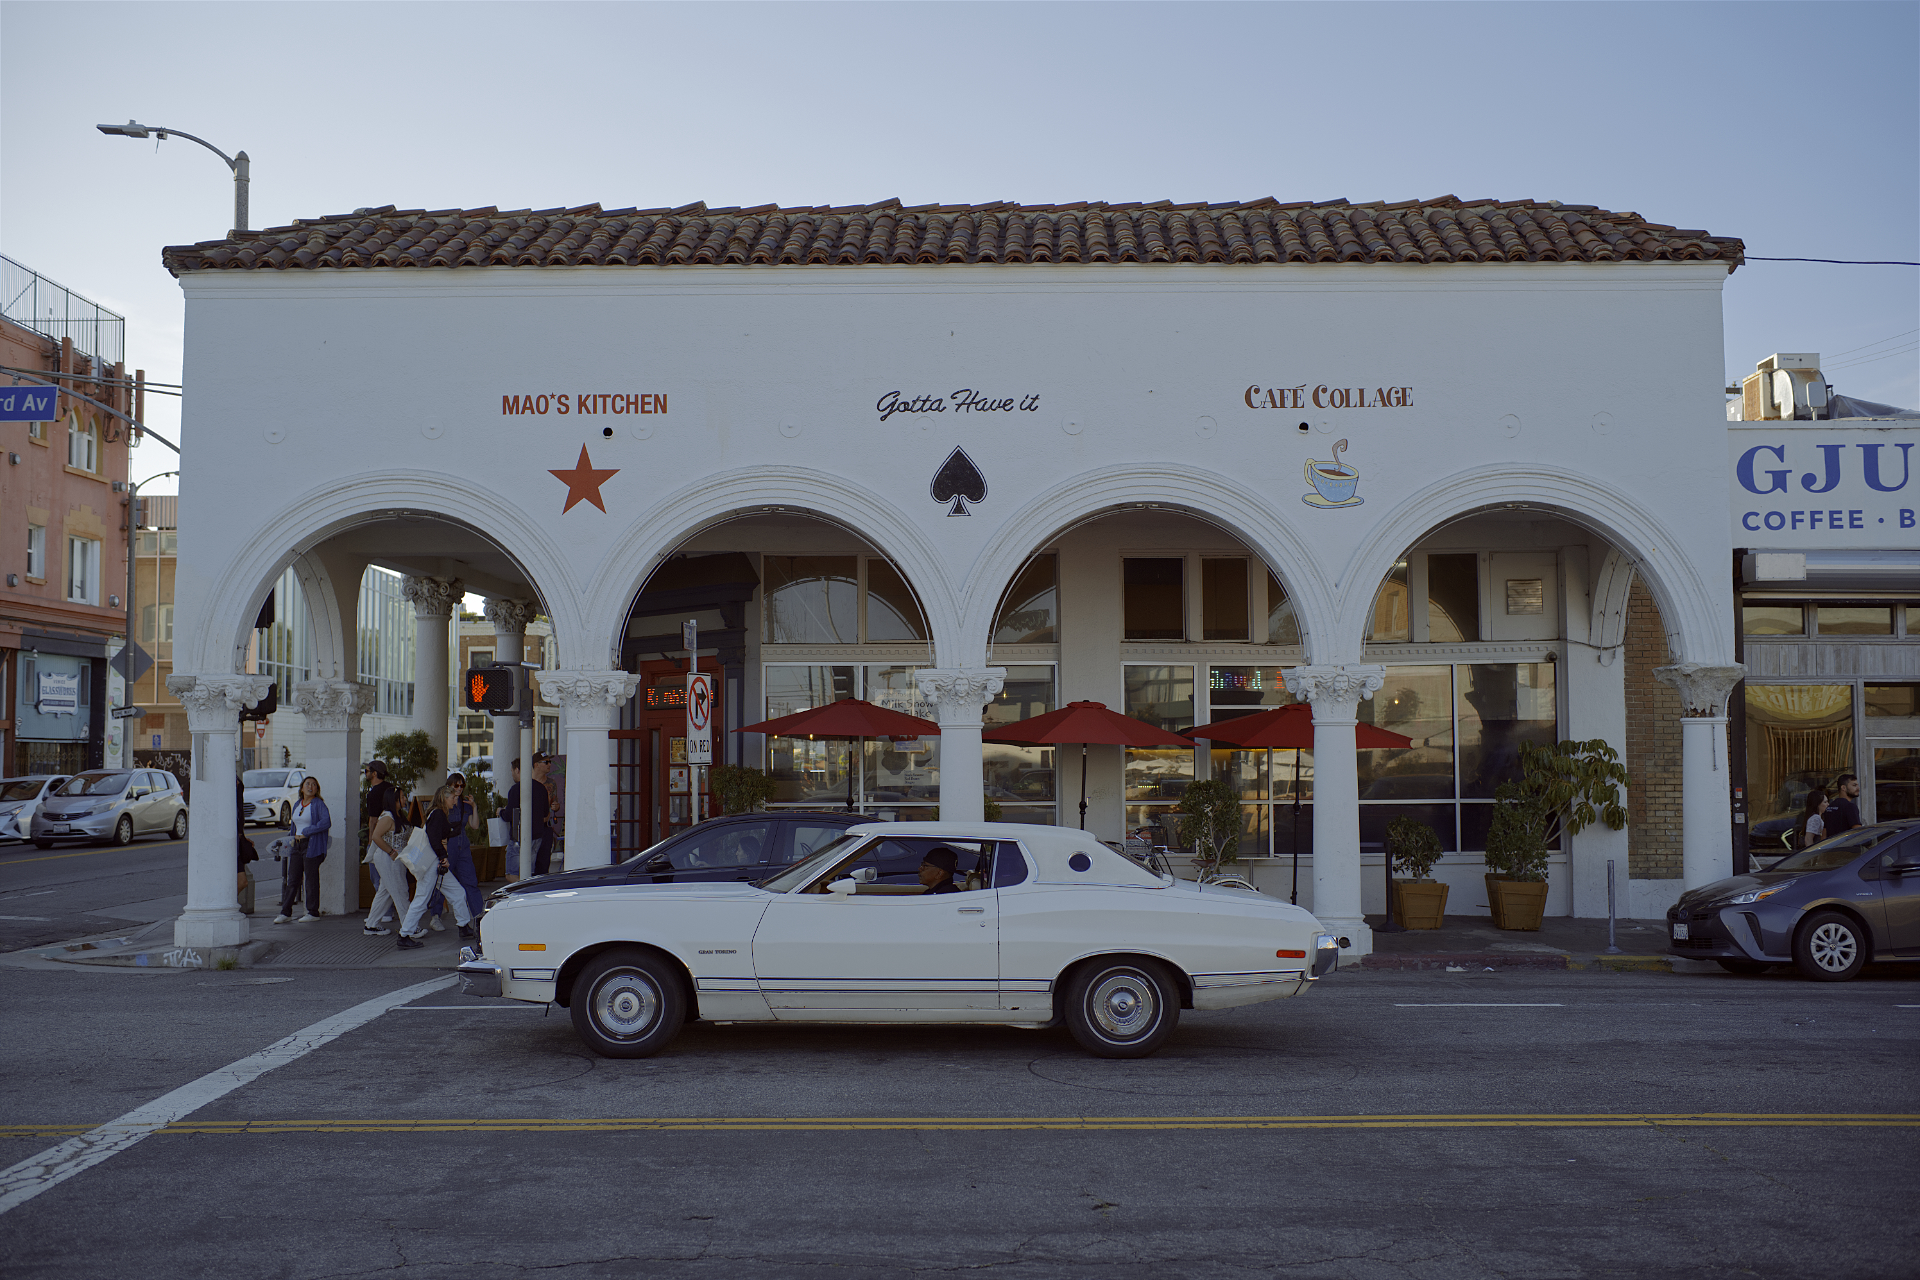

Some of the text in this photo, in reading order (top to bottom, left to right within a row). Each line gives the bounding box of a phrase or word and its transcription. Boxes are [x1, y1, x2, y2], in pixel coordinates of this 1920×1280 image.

[21, 393, 49, 412] Av
[577, 393, 668, 415] KITCHEN
[876, 388, 1040, 421] Gotta Have it
[1244, 384, 1414, 409] CAFÉ COLLAGE
[1736, 443, 1915, 495] GJU
[1742, 508, 1916, 531] COFFEE B
[881, 699, 904, 709] Milk
[690, 739, 698, 754] ON
[699, 739, 710, 753] RED
